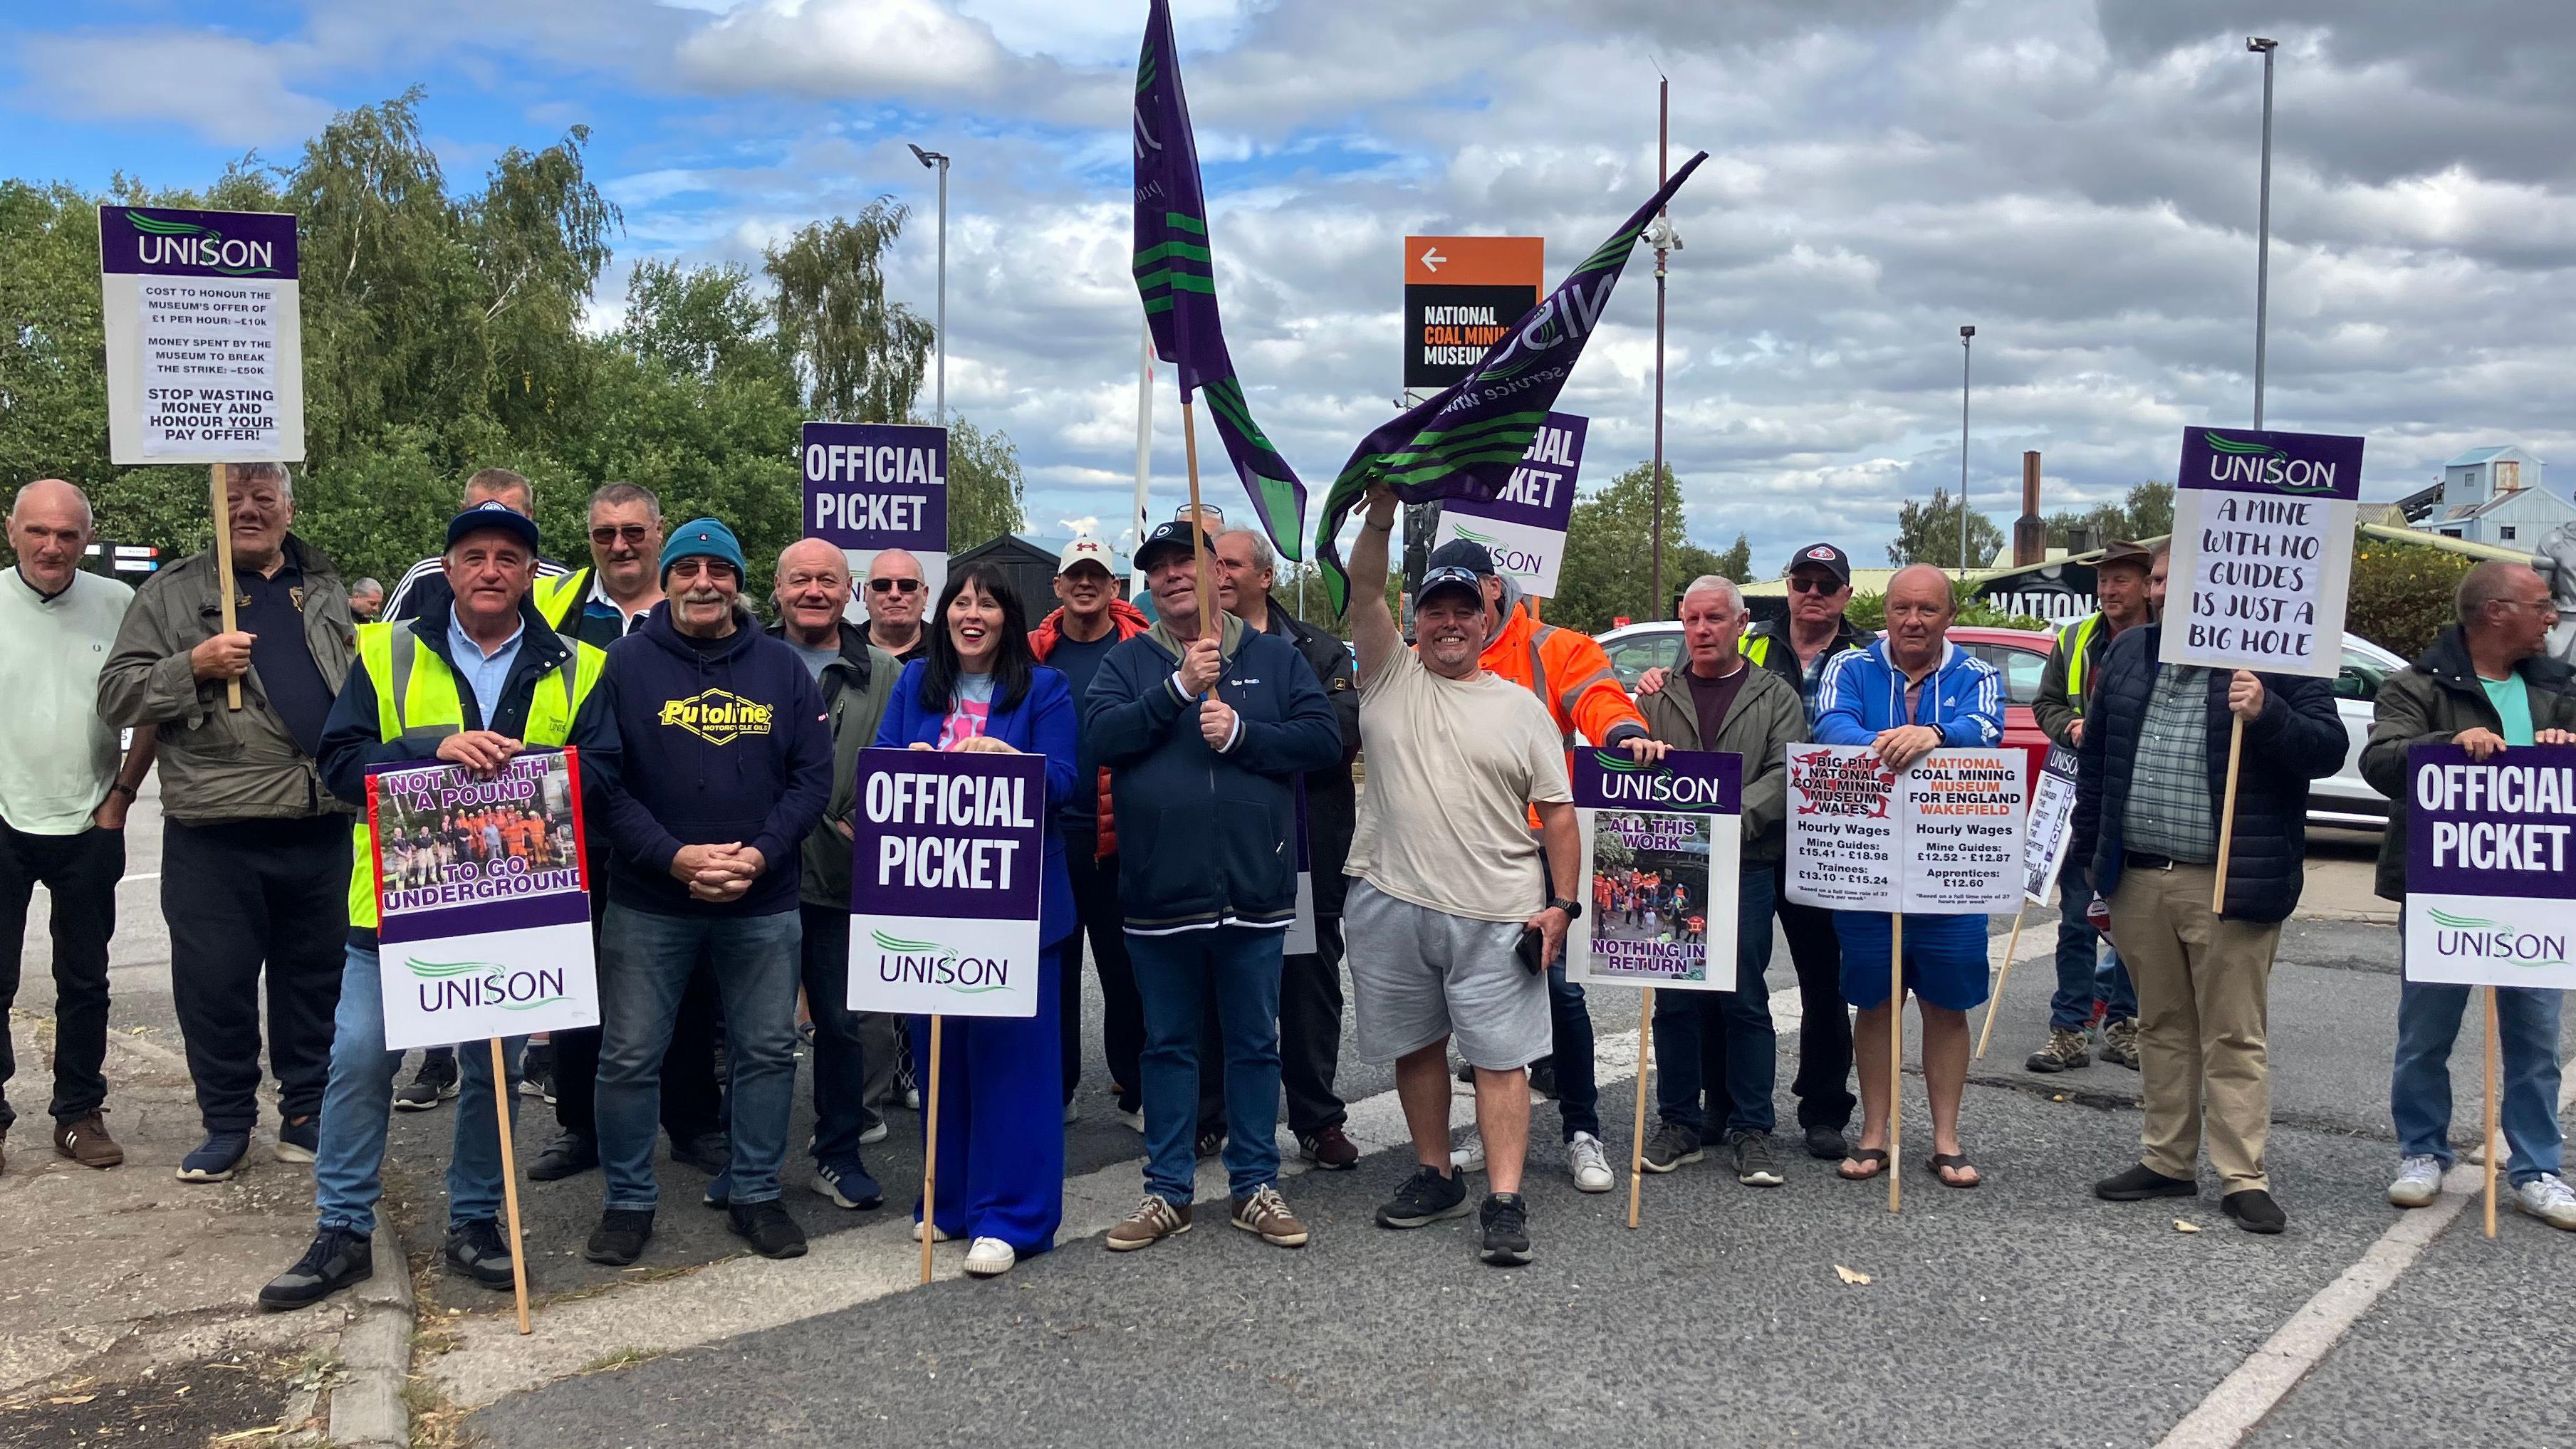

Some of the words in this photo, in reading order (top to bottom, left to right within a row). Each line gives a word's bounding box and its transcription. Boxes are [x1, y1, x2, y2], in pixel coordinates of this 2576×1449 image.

[139, 236, 272, 268] UNISON
[200, 290, 246, 299] HONOUR
[149, 301, 209, 310] MUSEUM'S
[1424, 306, 1497, 325] NATIONAL
[1425, 326, 1461, 345] COAL
[1424, 347, 1489, 365] MUSEUM
[148, 389, 194, 400] STOP
[199, 390, 273, 401] WASTING
[162, 402, 223, 414] MONEY
[229, 404, 262, 414] AND
[150, 416, 223, 427] HONOUR
[229, 417, 273, 427] YOUR
[166, 429, 196, 440] PAY
[202, 430, 259, 440] OFFER!
[806, 444, 944, 484] OFFICIAL
[2211, 455, 2335, 488] UNISON
[1496, 467, 1562, 508] KET
[816, 493, 927, 531] PICKET
[2218, 498, 2236, 521] A
[2246, 500, 2311, 525] MINE
[2203, 529, 2270, 556] WITH
[2281, 535, 2319, 560] NO
[2209, 562, 2303, 592] GUIDES
[1990, 592, 2102, 622] NATION
[2193, 592, 2214, 616] IS
[2225, 595, 2288, 623] JUST
[2294, 602, 2313, 625] A
[2189, 624, 2232, 649] BIG
[2241, 629, 2312, 655] HOLE
[663, 701, 768, 723] Putoline
[1818, 757, 1842, 768] BIG
[1848, 758, 1871, 768] PIT
[1927, 758, 2004, 769] NATIONAL
[1810, 768, 1879, 781] NATONAL
[1912, 769, 1952, 780] COAL
[1959, 770, 2015, 780] MINING
[390, 772, 444, 795] NOT
[1602, 773, 1719, 802] UNISON
[1793, 778, 1831, 790] COAL
[1837, 780, 1892, 792] MINING
[1931, 782, 2000, 792] MUSEUM
[2417, 763, 2576, 815] OFFICIAL
[414, 794, 435, 811] A
[442, 780, 535, 808] POUND
[866, 771, 1034, 827] OFFICIAL
[1810, 790, 1877, 803] MUSEUM
[1910, 792, 1940, 802] FOR
[1946, 793, 2020, 803] ENGLAND
[1818, 802, 1869, 815] WALES
[1920, 805, 2010, 815] WAKEFIELD
[1610, 819, 1645, 833] ALL
[1652, 820, 1696, 836] THIS
[1798, 820, 1840, 835] Hourly
[1845, 825, 1890, 837] Wages
[1917, 824, 1961, 836] Hourly
[1967, 825, 2012, 837] Wages
[1622, 834, 1682, 850] WORK
[1807, 838, 1832, 847] Mine
[1837, 840, 1879, 850] Guides:
[1959, 843, 2002, 852] Guides:
[2433, 822, 2570, 871] PICKET
[1799, 847, 1835, 857] £15.41
[1849, 851, 1888, 860] £18.98
[443, 862, 478, 884] TO
[486, 856, 526, 877] GO
[879, 836, 1019, 889] PICKET
[1818, 862, 1867, 874] Trainees:
[1799, 871, 1835, 881] £13.10
[1849, 875, 1887, 884] £15.24
[1927, 869, 2000, 878] Apprentices:
[1592, 939, 1679, 958] NOTHING
[1687, 943, 1705, 959] IN
[2438, 931, 2565, 960] UNISON
[880, 955, 1008, 985] UNISON
[1609, 957, 1687, 973] RETURN
[419, 968, 563, 1011] UNISON
